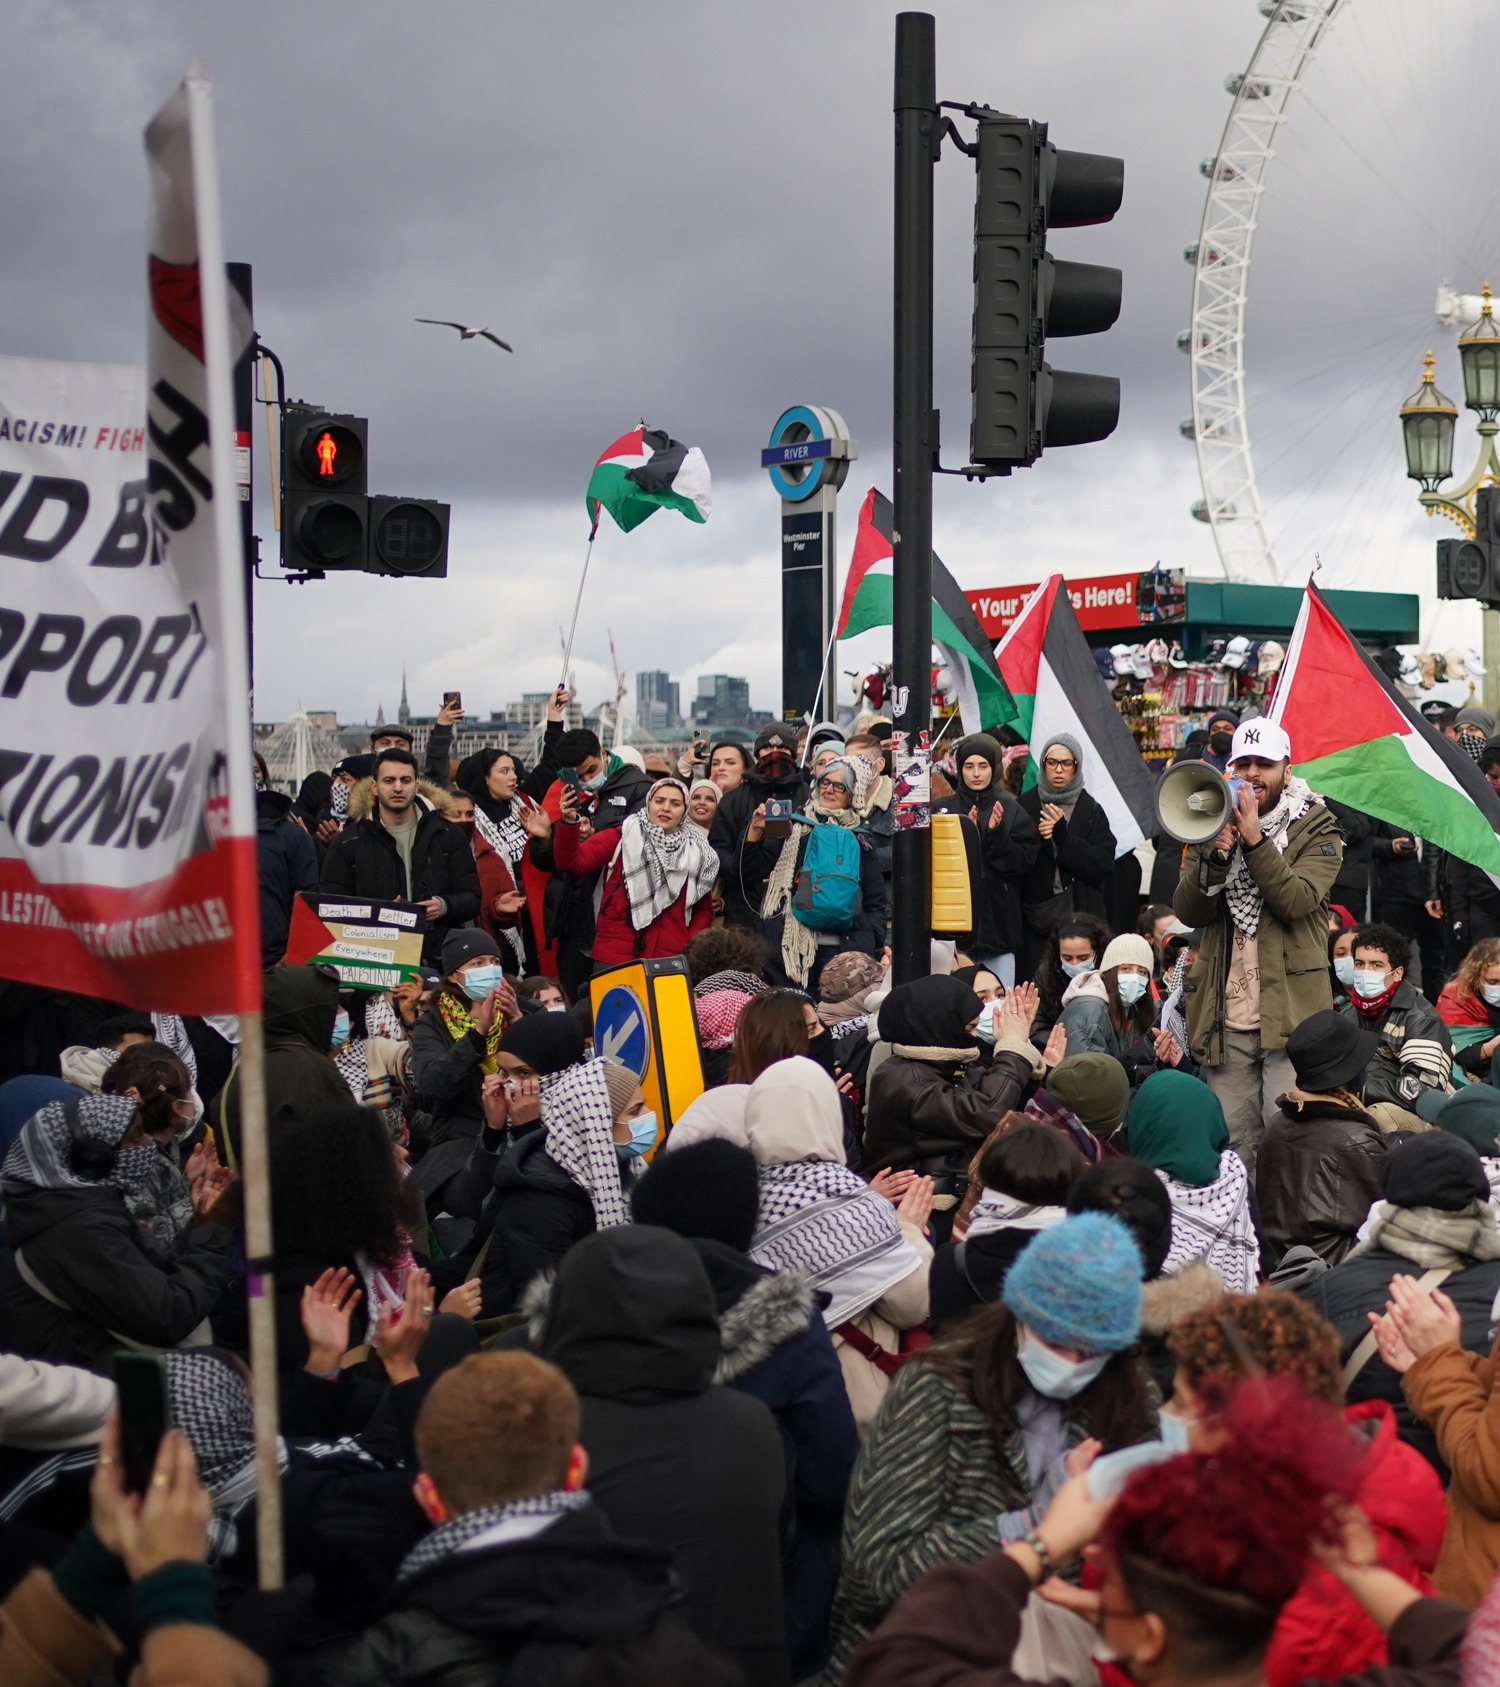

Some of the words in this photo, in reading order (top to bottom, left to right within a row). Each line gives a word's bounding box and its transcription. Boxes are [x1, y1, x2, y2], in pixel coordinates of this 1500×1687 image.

[784, 446, 809, 460] RIVER
[783, 531, 821, 543] Westminster
[793, 542, 806, 551] Pier
[979, 597, 1019, 618] Your
[1084, 582, 1132, 609] Here!
[1244, 728, 1261, 744] NY
[319, 906, 352, 918] Death
[359, 909, 370, 919] to
[380, 911, 415, 926] settler
[343, 927, 396, 940] Colonialism
[335, 944, 392, 960] Everywhere!
[341, 966, 398, 987] PALESTINA!
